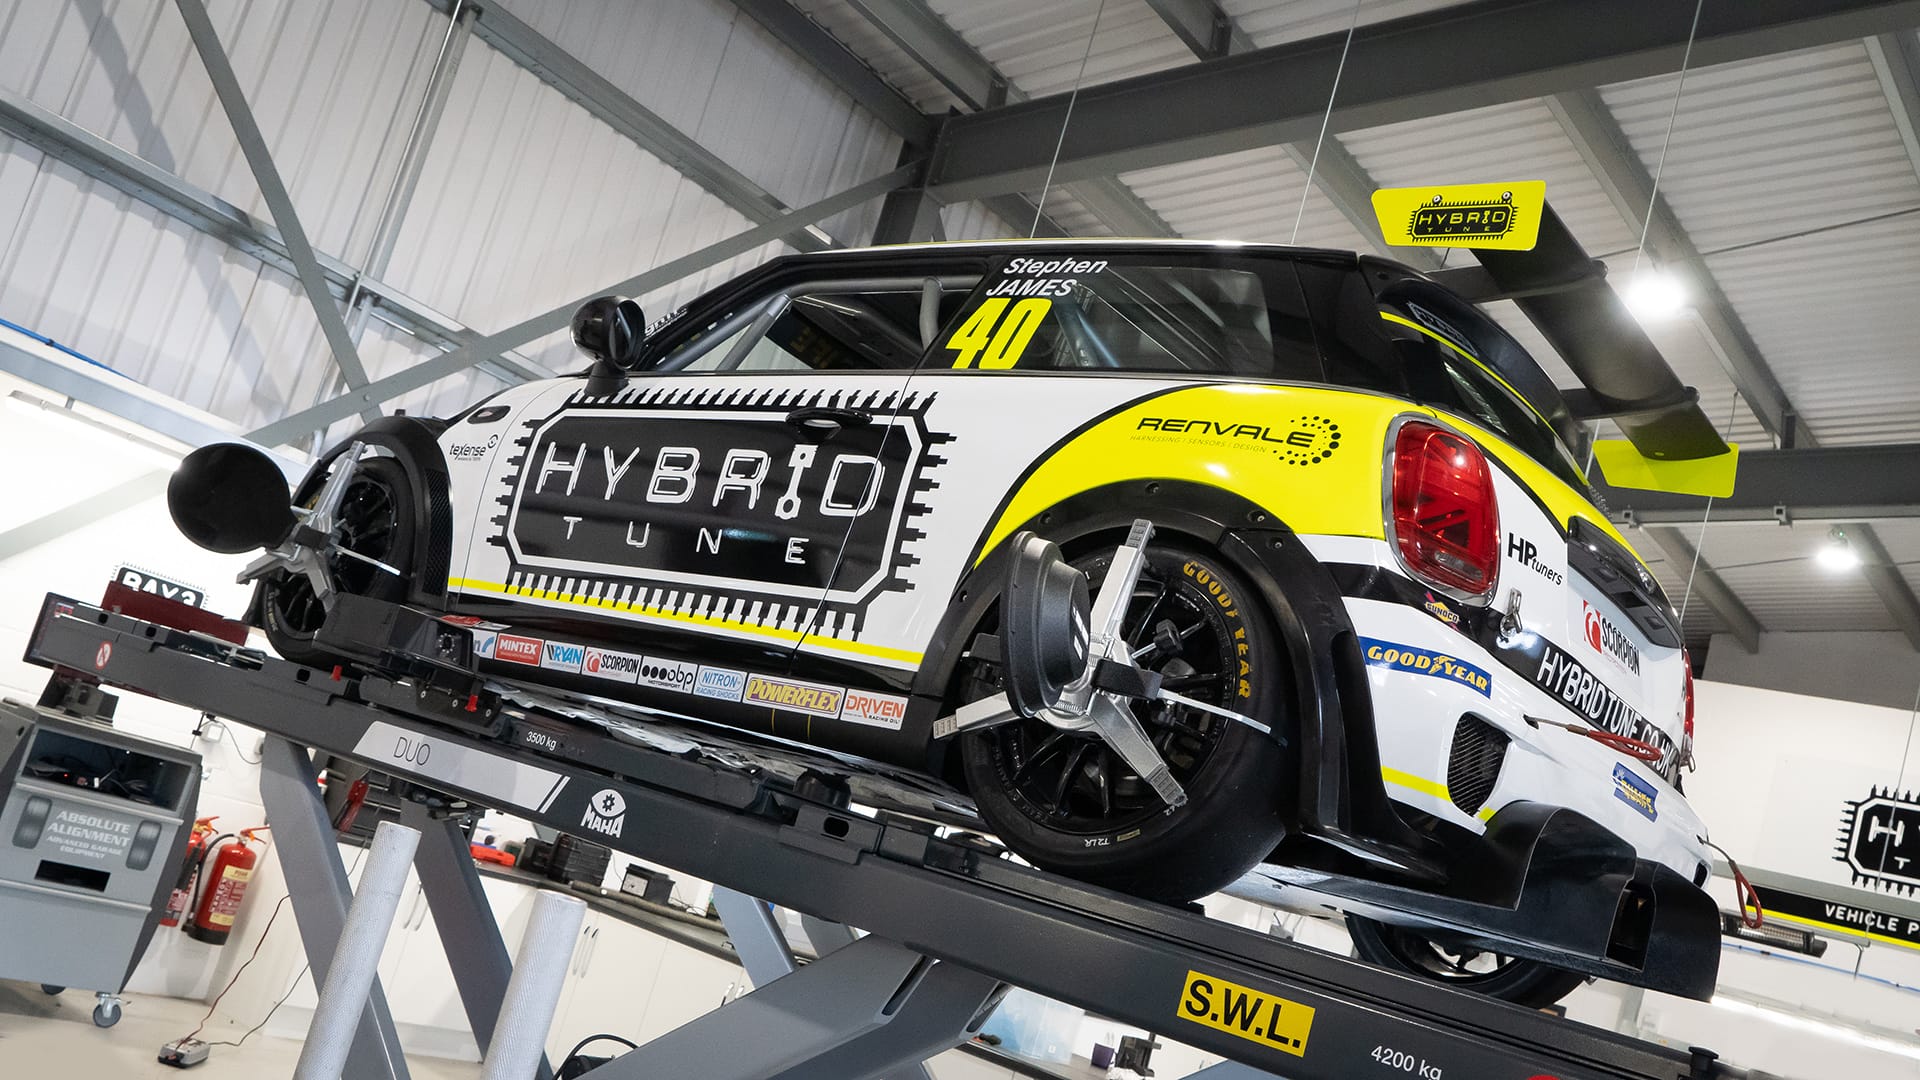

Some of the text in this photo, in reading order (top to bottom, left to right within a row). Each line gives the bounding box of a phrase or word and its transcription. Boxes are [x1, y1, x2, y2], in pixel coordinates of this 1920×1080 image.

[1418, 210, 1506, 225] HYBRID
[1427, 225, 1491, 233] TUNE
[1003, 257, 1108, 278] Stephen
[986, 279, 1078, 297] JAMES
[945, 298, 1053, 370] 40
[1136, 417, 1316, 448] RENVALE
[1232, 442, 1267, 453] DESIGN
[535, 440, 886, 520] HYBRID
[563, 515, 810, 565] TUNE
[1426, 602, 1458, 623] SUNOCO
[499, 638, 538, 655] MINTEX
[553, 645, 584, 665] RYAN
[1601, 617, 1641, 677] SCORPION
[600, 653, 640, 674] SCORPION
[701, 671, 738, 688] NITRON
[696, 687, 740, 699] RACING SHOCKS
[747, 678, 841, 712] POWERFLEX
[844, 694, 905, 719] DRIVEN
[393, 736, 431, 766] DUO
[526, 731, 557, 751] 3500 kg
[56, 810, 131, 834] ABSOLUTE
[580, 803, 625, 839] MAHA
[47, 822, 131, 847] ALIGNMENT
[59, 845, 106, 858] EQUIPMENT
[1825, 903, 1899, 932] VEHICLE
[1185, 978, 1303, 1048] S.W.L.
[1371, 1045, 1443, 1080] 4200 kg
